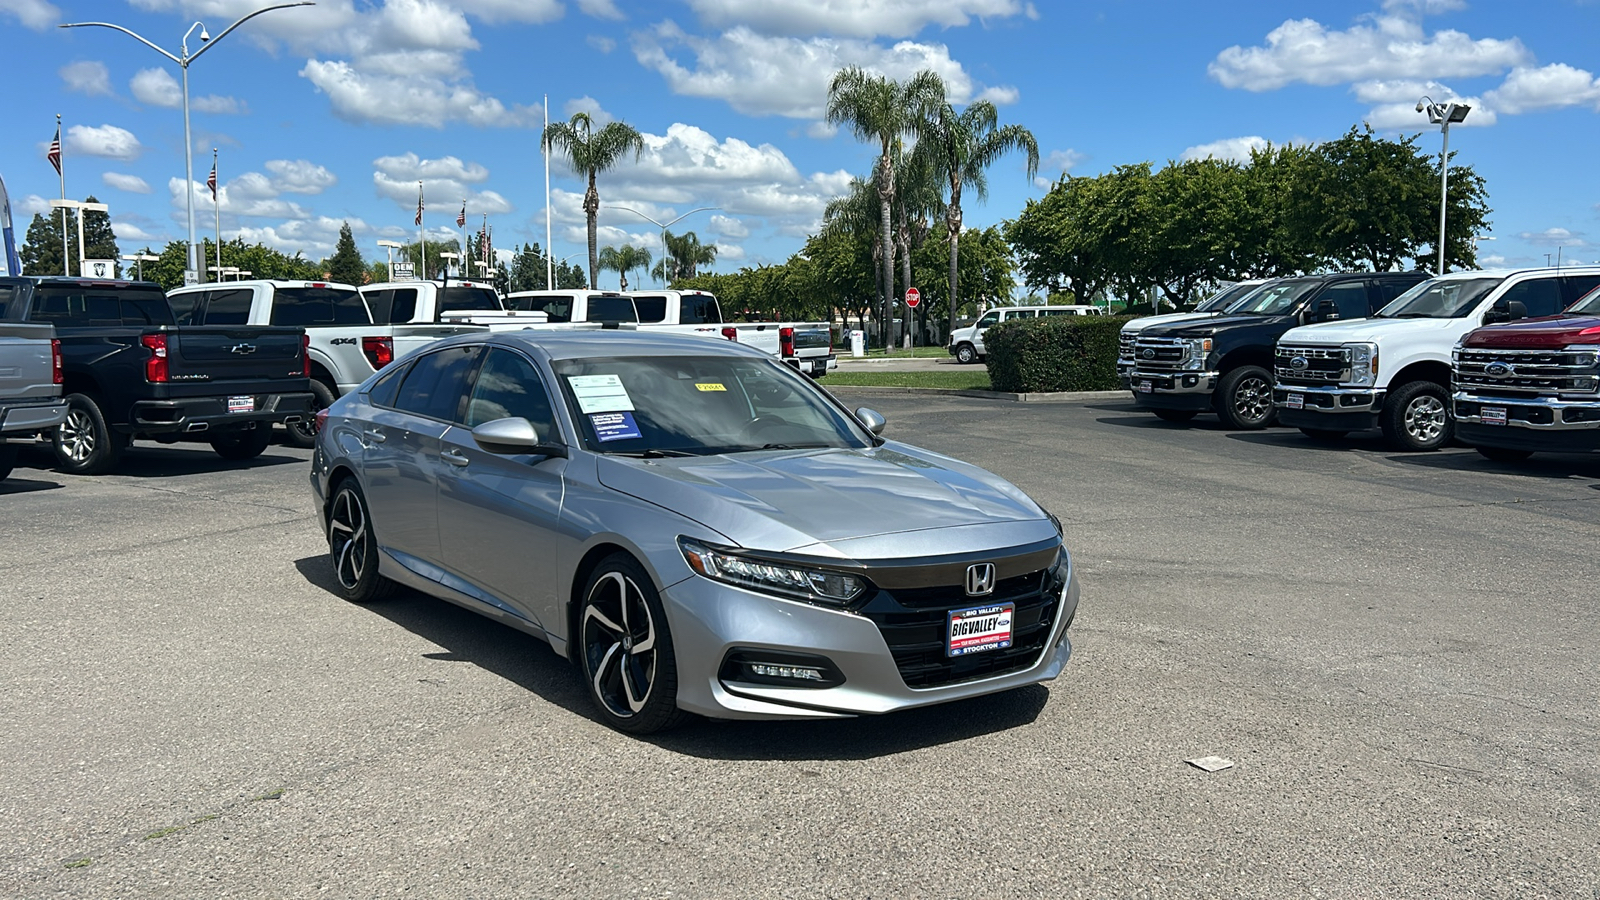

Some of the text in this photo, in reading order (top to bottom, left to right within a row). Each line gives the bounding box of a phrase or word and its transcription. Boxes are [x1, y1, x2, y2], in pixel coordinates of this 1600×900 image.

[907, 293, 919, 301] STOP
[978, 606, 1000, 614] VALLEY
[952, 617, 999, 637] BIGVALLEY
[963, 643, 998, 653] STOCKTON
